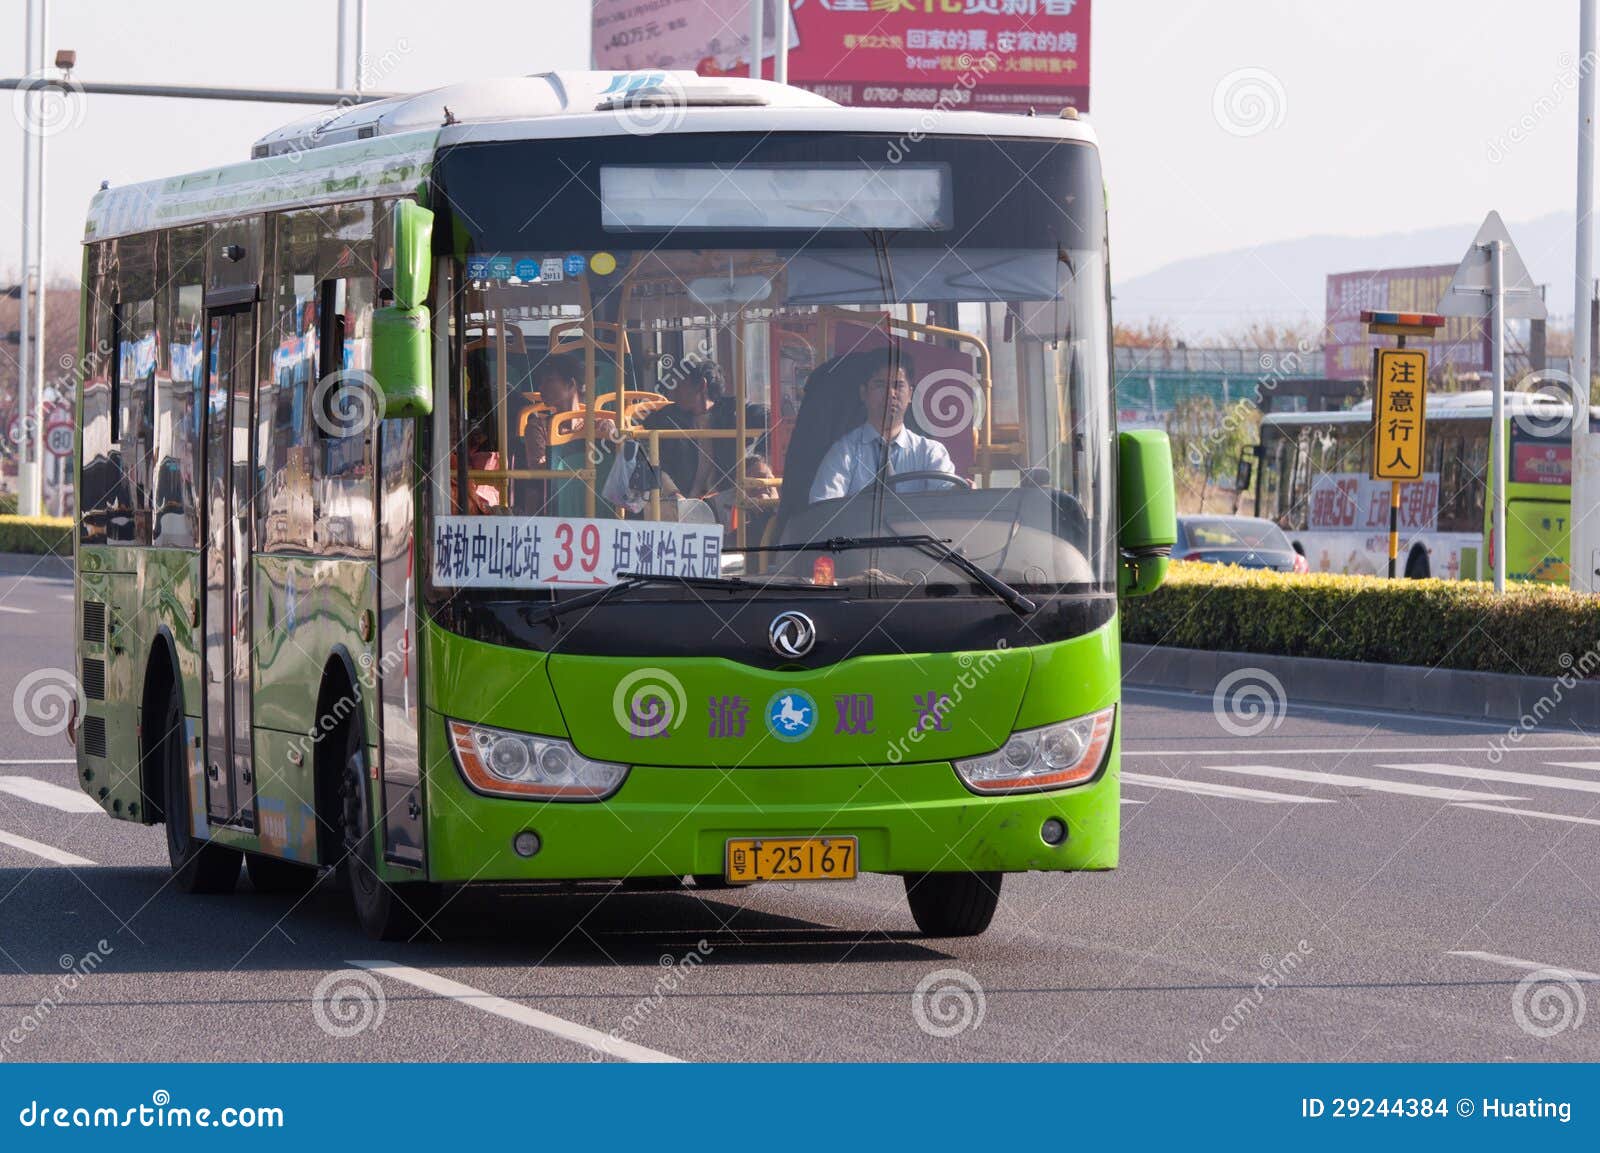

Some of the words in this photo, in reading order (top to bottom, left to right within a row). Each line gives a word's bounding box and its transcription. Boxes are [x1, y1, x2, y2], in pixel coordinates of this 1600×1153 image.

[1387, 361, 1415, 470] 注意行人
[436, 523, 541, 579] 城轨中山北站
[553, 523, 601, 572] 39
